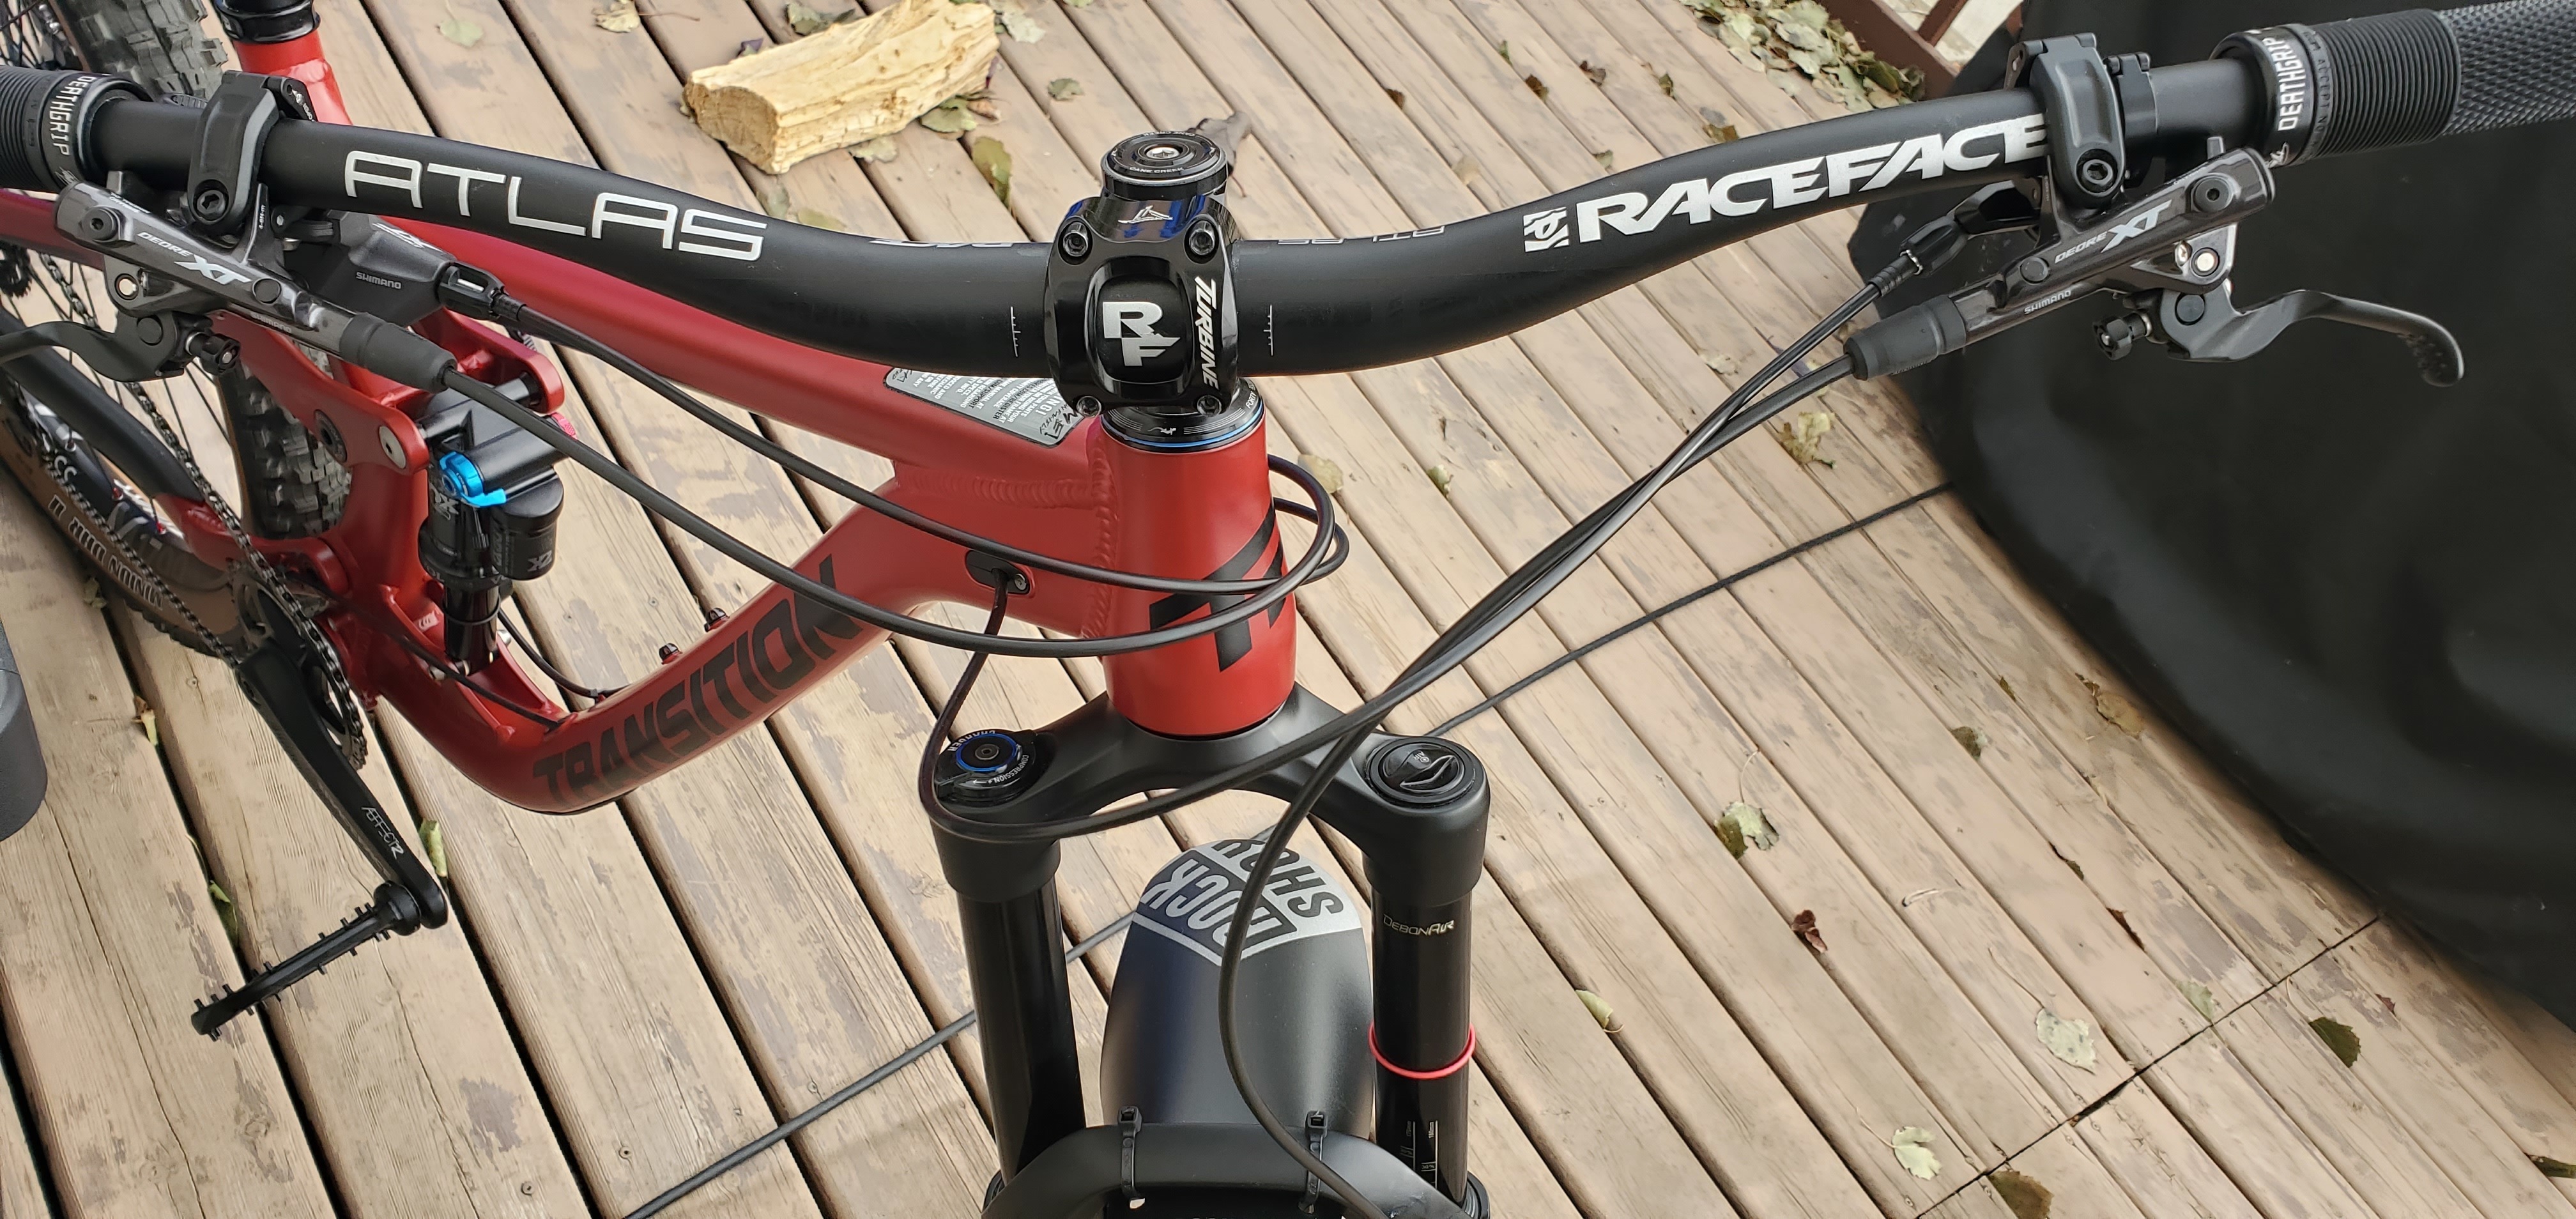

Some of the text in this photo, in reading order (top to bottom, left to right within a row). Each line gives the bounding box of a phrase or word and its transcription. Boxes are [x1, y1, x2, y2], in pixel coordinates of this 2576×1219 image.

[2262, 37, 2306, 132] DEATHGRIP
[49, 75, 97, 156] DEATHGRIP
[344, 150, 767, 261] ATLAS
[2055, 199, 2172, 264] DEORE XT
[137, 232, 252, 285] DEORE XT
[356, 272, 402, 289] SHIMANO
[2024, 289, 2072, 315] SHIMANO
[1195, 276, 1218, 390] TURBINE
[934, 387, 946, 399] AND
[960, 382, 986, 408] REGARDING
[981, 384, 1003, 402] MANUAL
[993, 387, 1019, 408] COVERAGE
[1245, 391, 1257, 409] FORTY
[1004, 399, 1022, 416] FRAME
[1006, 408, 1023, 422] YOUR
[1020, 401, 1038, 417] PANTS
[533, 553, 864, 808] TRANSITION
[994, 755, 1030, 784] COMPRESSION
